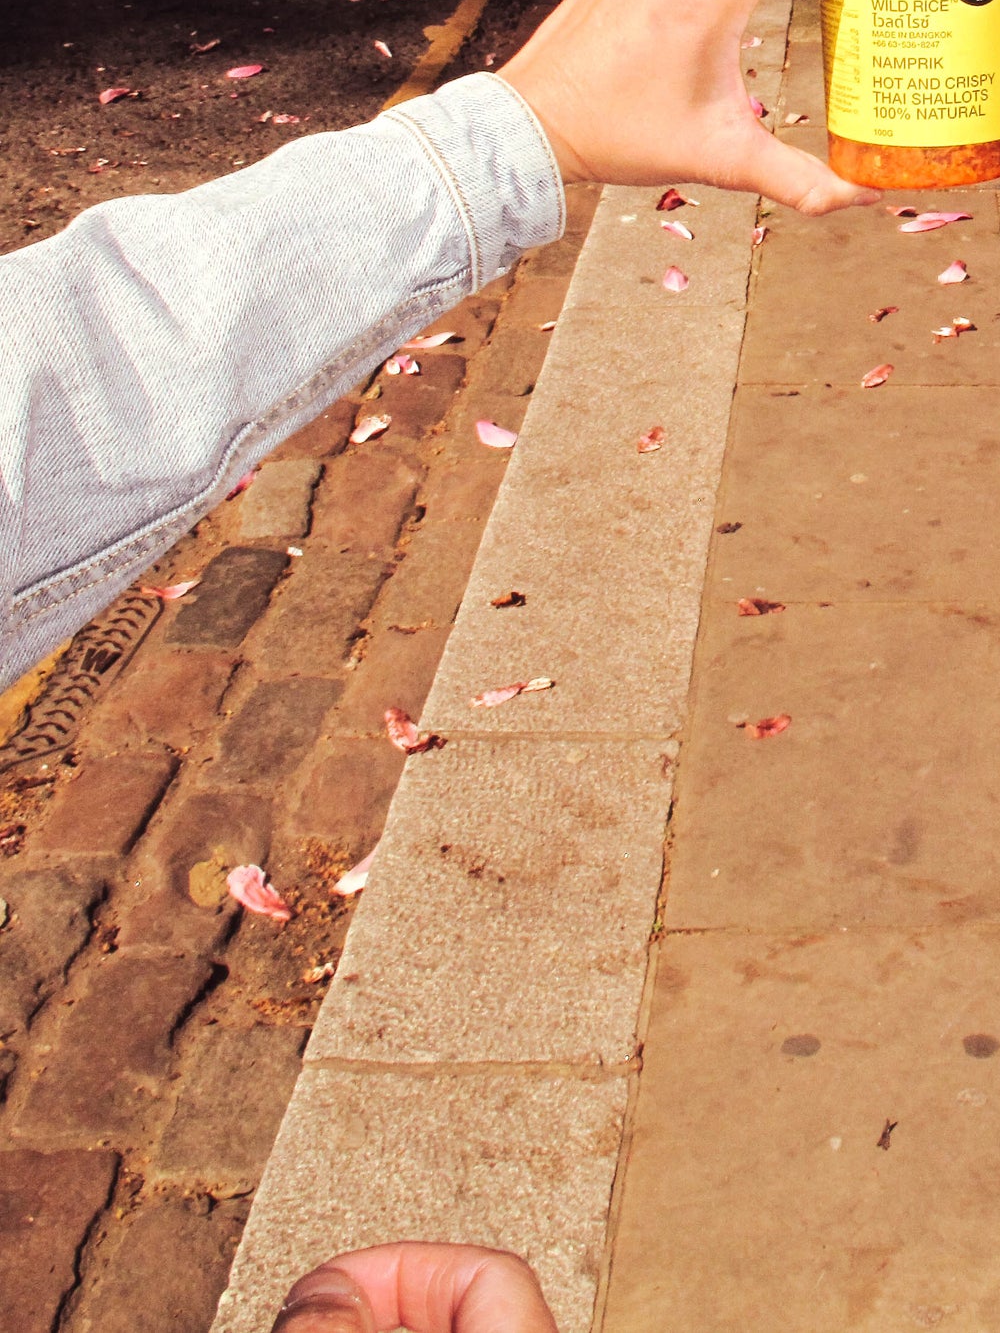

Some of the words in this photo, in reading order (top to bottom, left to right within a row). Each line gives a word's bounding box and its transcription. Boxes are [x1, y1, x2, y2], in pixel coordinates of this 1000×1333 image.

[872, 30, 896, 39] MADE
[898, 31, 907, 39] IN
[909, 30, 953, 39] BANGKOK
[872, 56, 944, 70] NAMPRIK
[873, 76, 903, 90] HOT
[907, 77, 941, 90] AND
[945, 73, 996, 90] CRISPY
[873, 90, 906, 105] THAI
[911, 89, 989, 105] SHALLOTS
[873, 106, 911, 121] 100%
[916, 104, 986, 121] NATURAL
